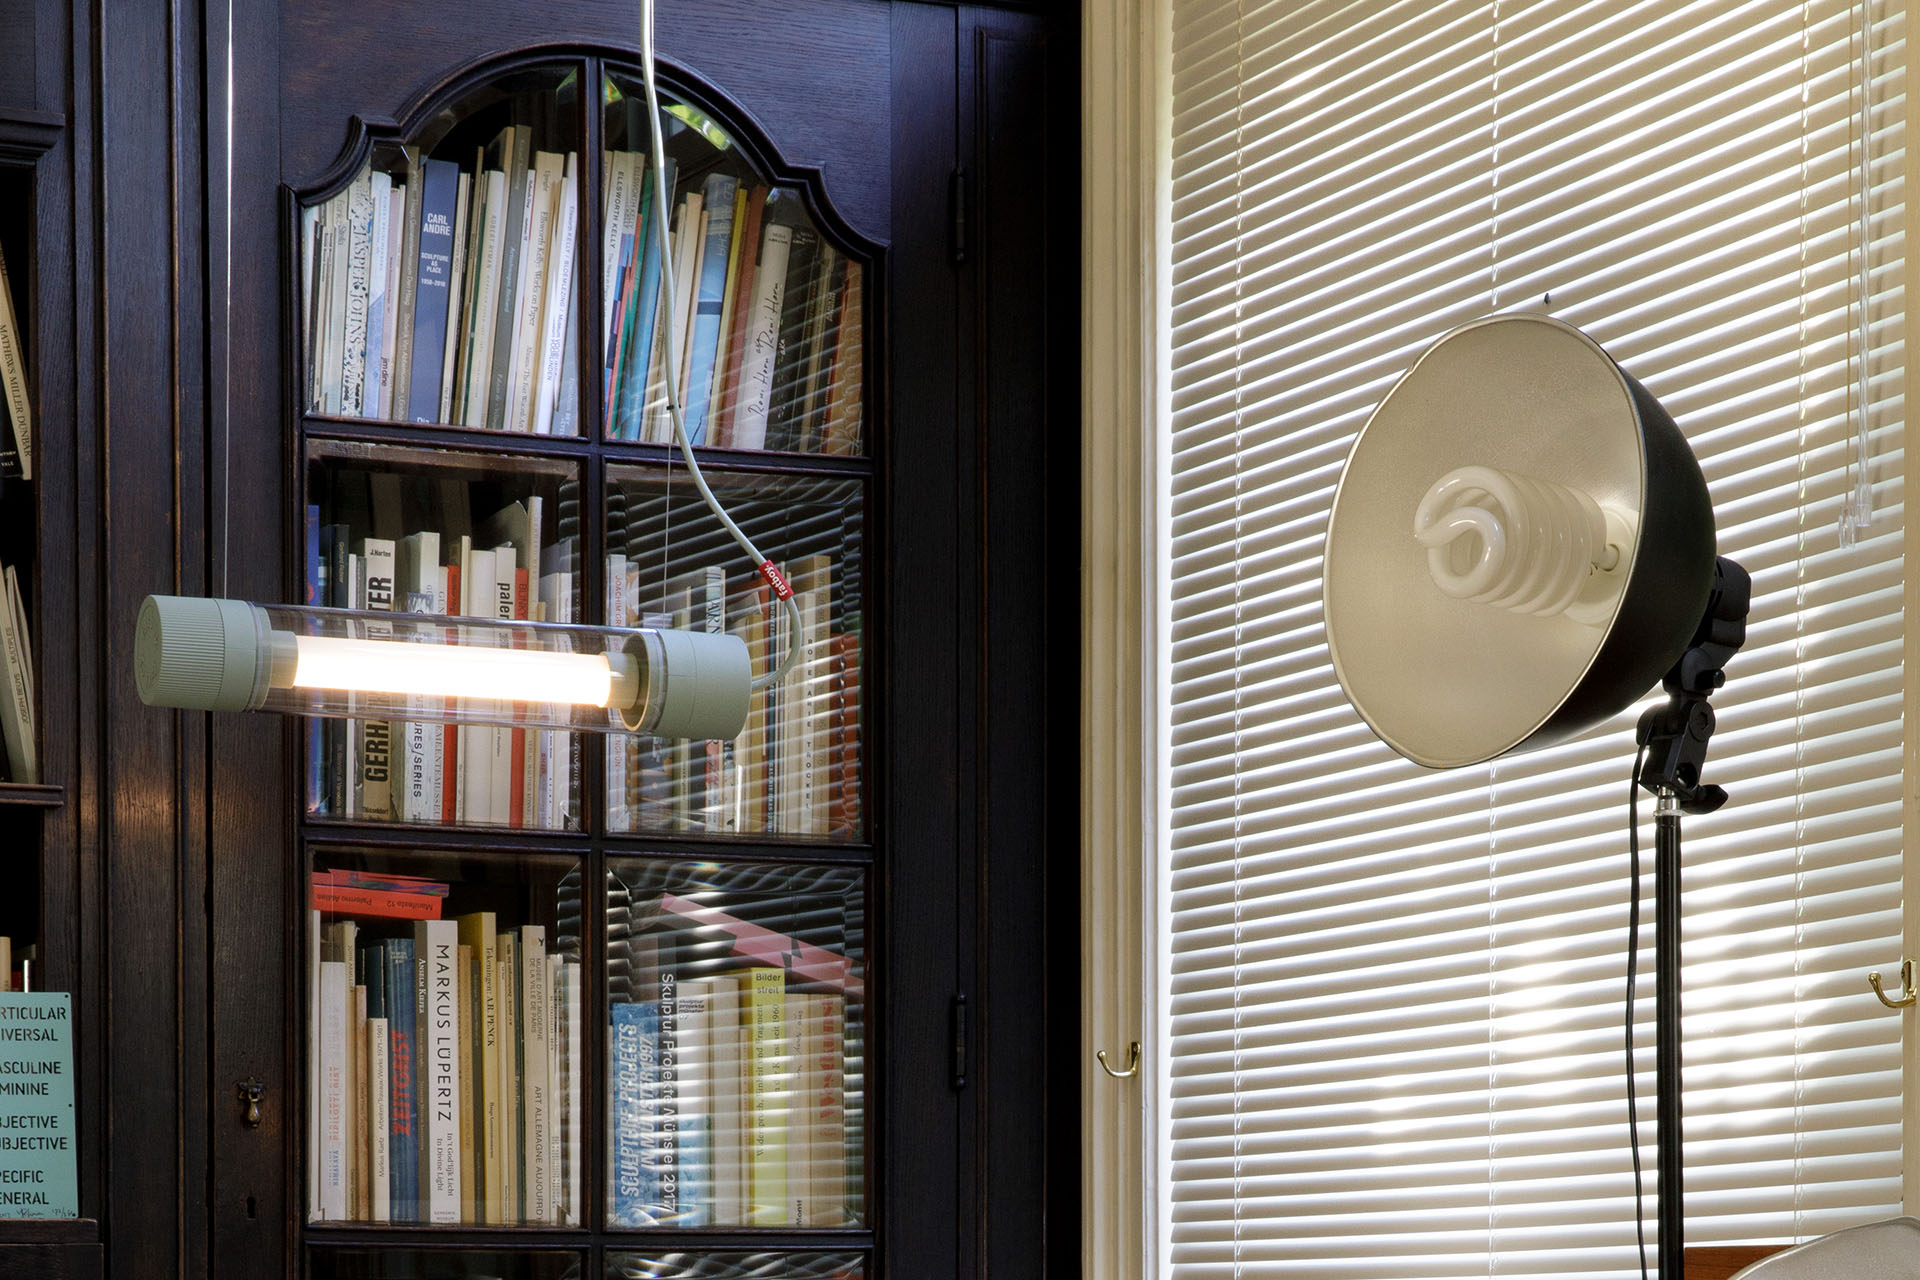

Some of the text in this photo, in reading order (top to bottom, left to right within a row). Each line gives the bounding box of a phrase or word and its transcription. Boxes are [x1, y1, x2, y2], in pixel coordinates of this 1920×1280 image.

[613, 171, 625, 221] ELLSWORTH
[427, 213, 447, 225] CARL
[538, 211, 550, 245] Ellsworth
[423, 223, 451, 236] ANDRE
[609, 223, 619, 250] KELLY
[565, 232, 573, 253] KELLY
[353, 231, 367, 285] JASPER
[421, 252, 449, 262] SCULPTURE
[426, 266, 442, 274] PLACE
[532, 270, 543, 293] Works
[532, 294, 539, 304] on
[349, 291, 364, 344] JOHNS
[529, 306, 539, 326] Paper
[381, 357, 389, 387] jim dine
[0, 324, 32, 458] MATHEWS MILLER DUNBAR
[497, 582, 513, 620] paler
[365, 720, 389, 782] GERH
[342, 895, 372, 906] Palermo
[397, 901, 433, 911] Manifesta
[529, 958, 536, 967] DE
[756, 973, 781, 981] Bilder
[530, 1000, 537, 1011] DE
[1, 1028, 59, 1042] IVERSAL
[436, 944, 452, 1122] MARKUS LÜPERTZ
[487, 1015, 496, 1048] PENCK
[639, 1035, 655, 1069] 1997
[391, 1028, 412, 1137] ZEITGEIST
[660, 973, 678, 1211] Skulptur Projekte Münster 2017
[535, 1086, 543, 1105] ART
[618, 1023, 640, 1198] SCULPTURE PROJECTS
[0, 1137, 67, 1151] BJECTIVE
[437, 1138, 444, 1146] In
[535, 1107, 543, 1164] ALLEMAGNE
[640, 1151, 655, 1170] IN
[435, 1172, 444, 1191] Light
[447, 1178, 455, 1197] Licht
